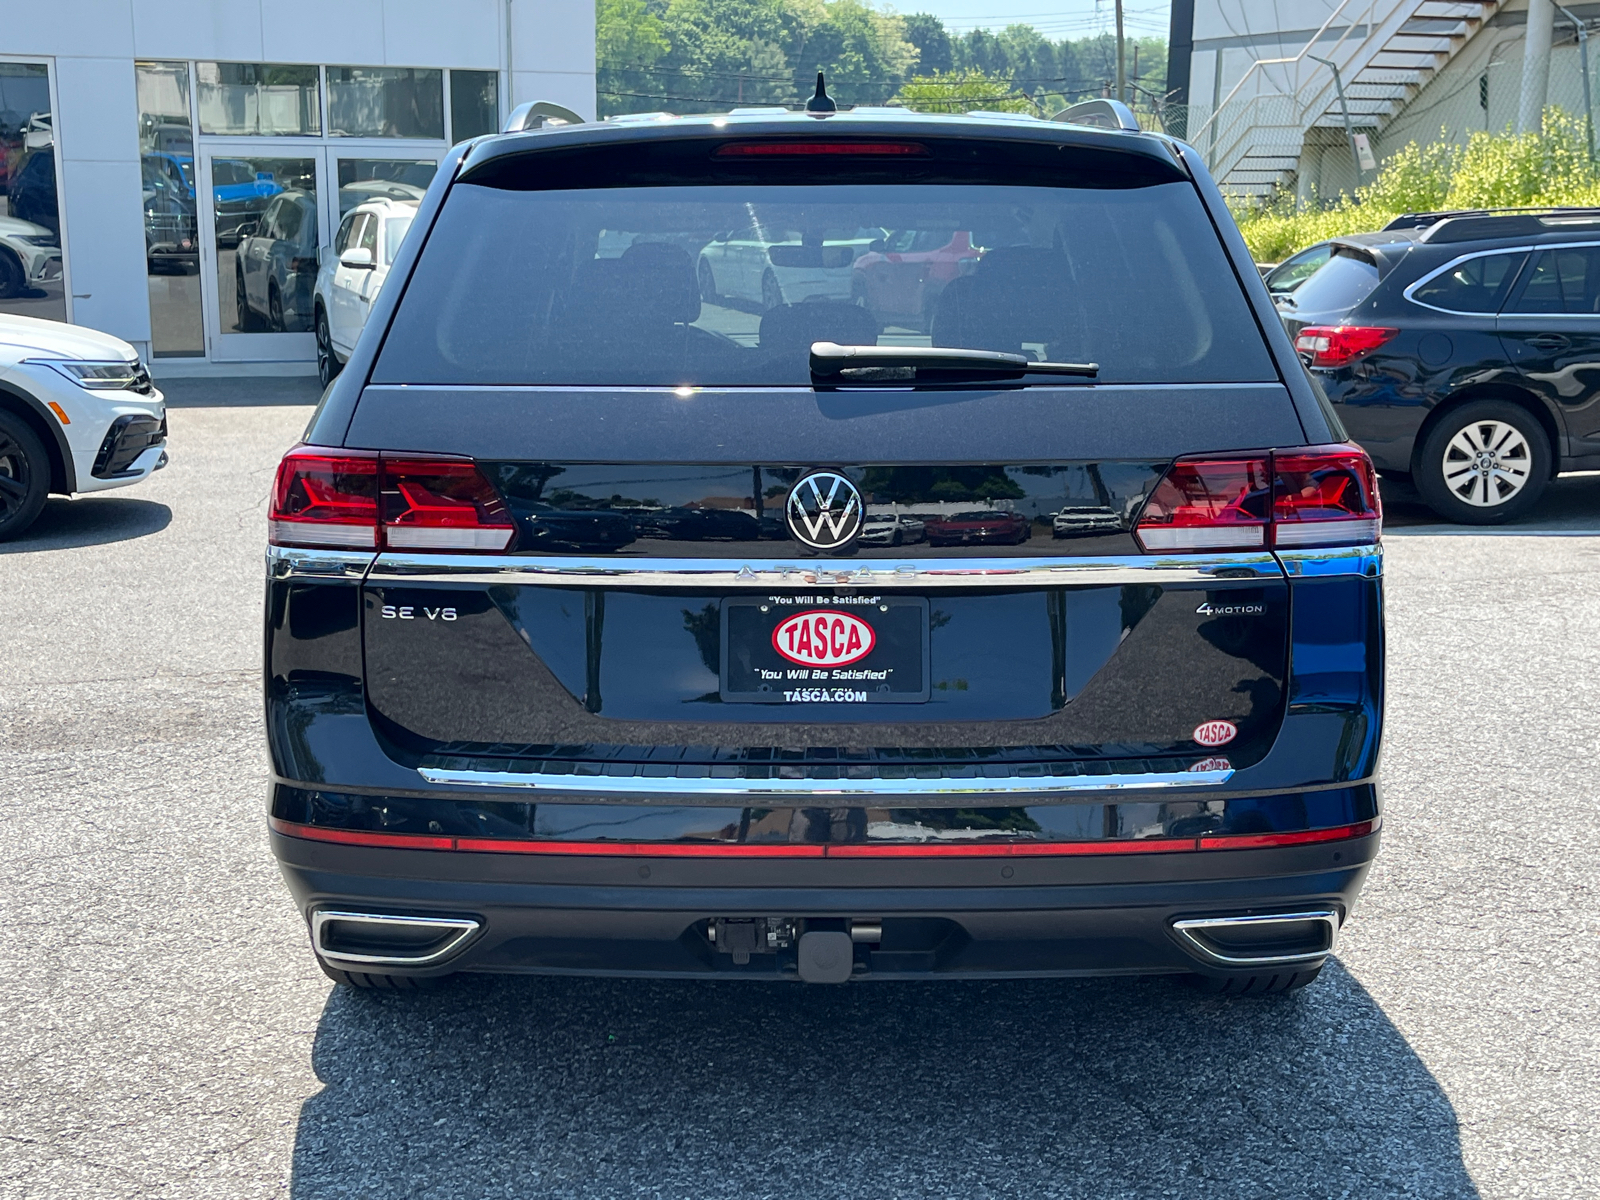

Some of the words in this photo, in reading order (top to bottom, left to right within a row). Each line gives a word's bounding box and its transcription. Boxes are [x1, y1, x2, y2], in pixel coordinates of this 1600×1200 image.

[734, 564, 916, 584] ATLAS
[795, 596, 813, 604] Will
[816, 596, 830, 604] Be
[381, 605, 415, 620] SE
[423, 607, 458, 621] V6
[784, 616, 863, 660] TASCA
[786, 669, 809, 680] Will
[811, 669, 829, 680] Be
[783, 691, 867, 702] TASCA.COM
[1199, 724, 1232, 743] TASCA
